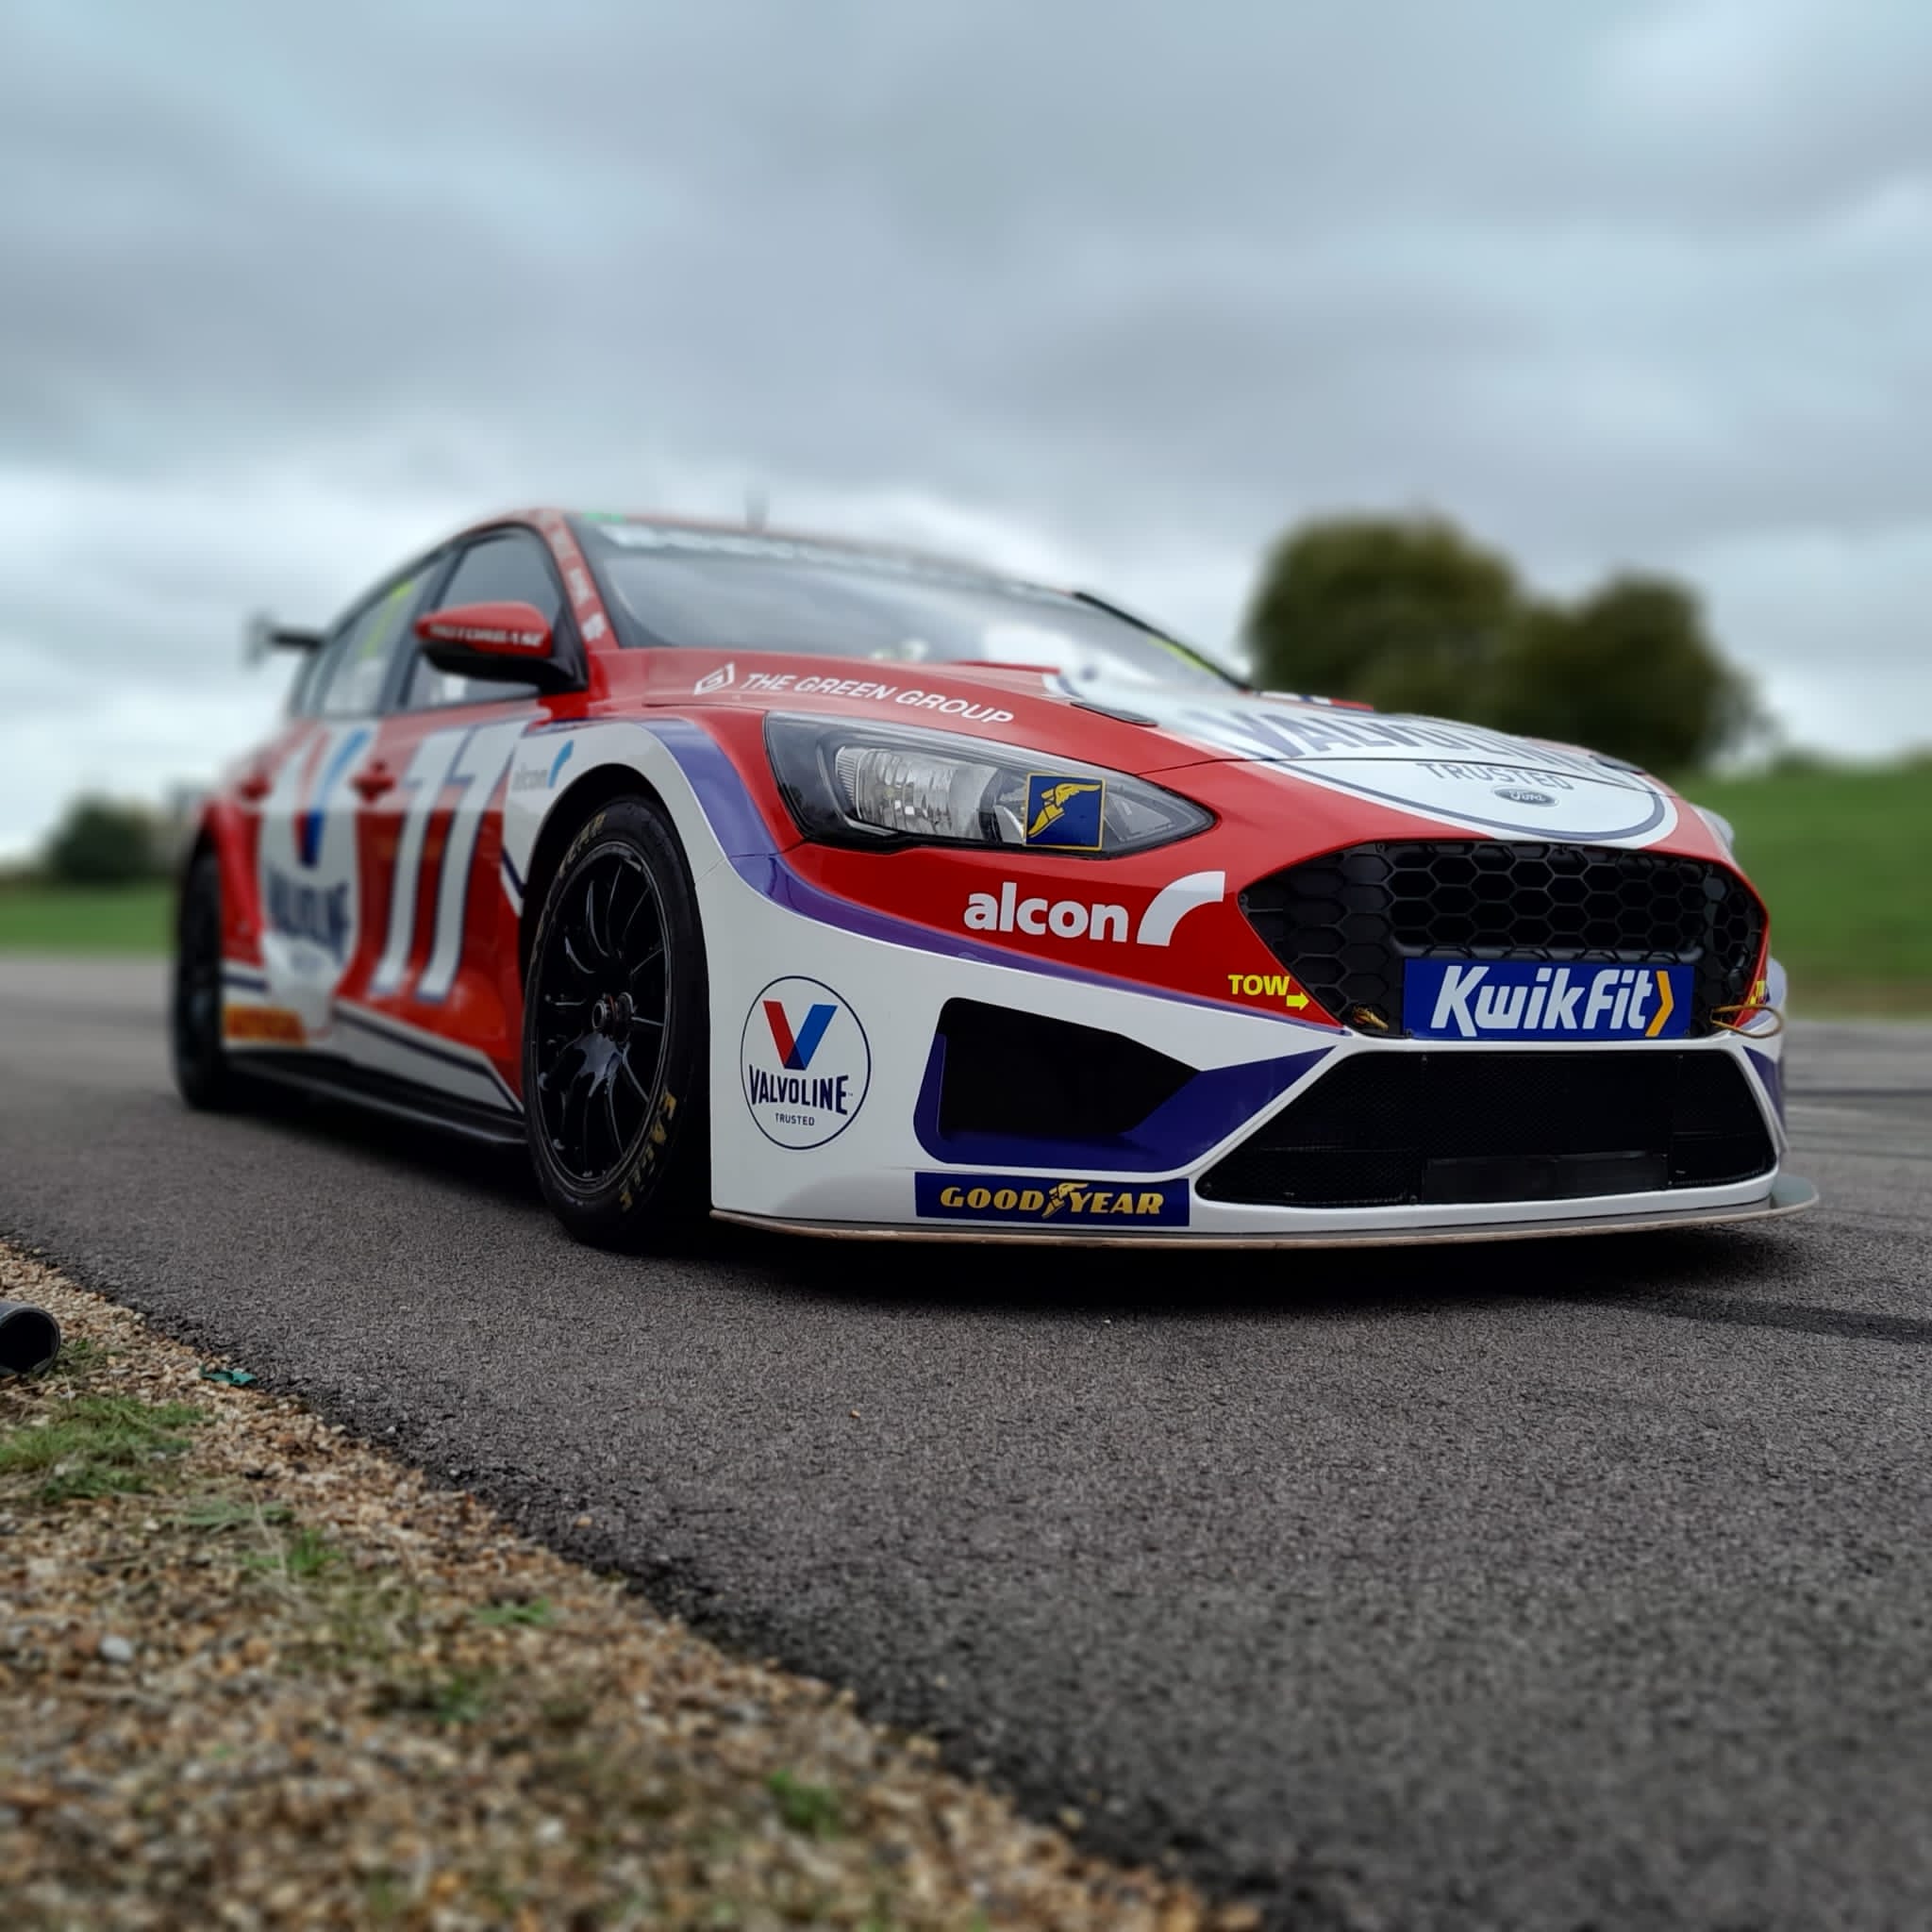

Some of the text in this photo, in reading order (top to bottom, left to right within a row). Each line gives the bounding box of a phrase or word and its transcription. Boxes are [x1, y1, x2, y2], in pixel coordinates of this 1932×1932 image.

[739, 673, 1015, 725] THE GREEN GROUP
[1416, 762, 1574, 791] TRUSTED
[962, 881, 1129, 942] alcon
[1227, 974, 1291, 996] TOW
[749, 1063, 849, 1116] VALVOLINE
[774, 1112, 815, 1126] TRUSTED
